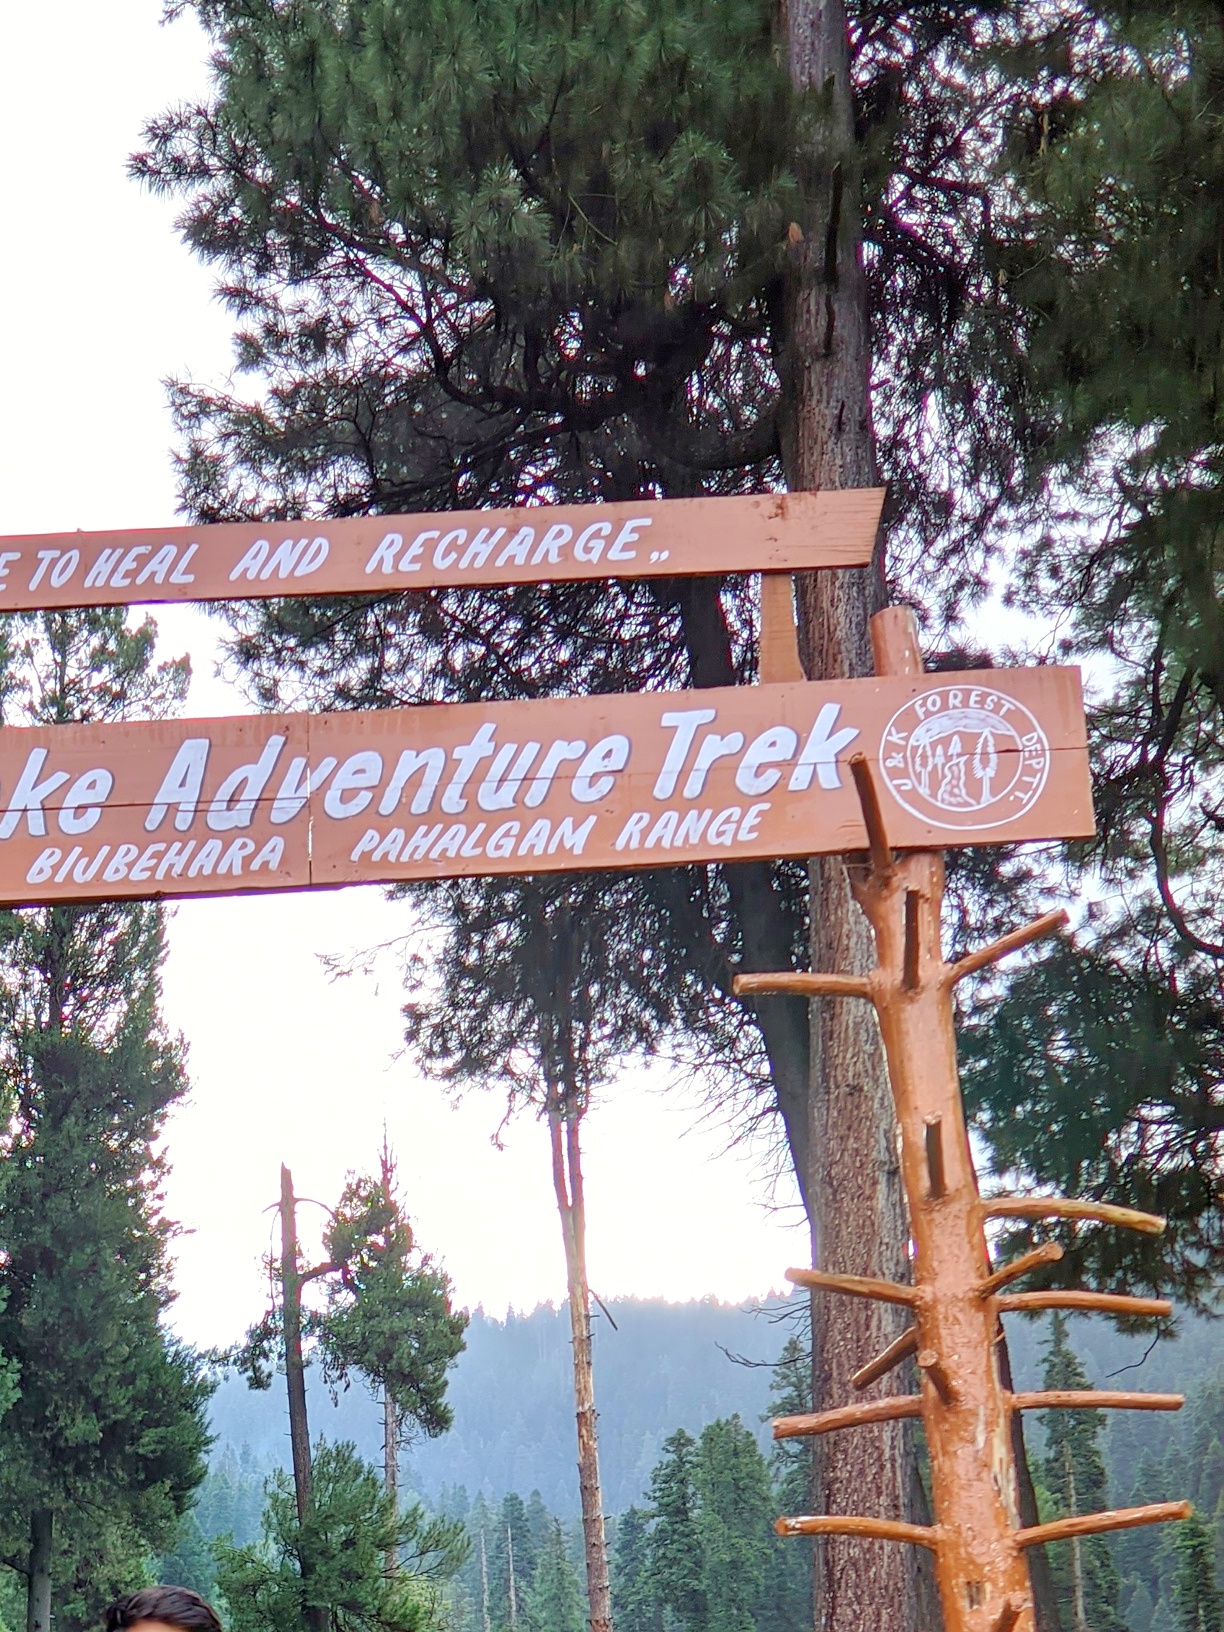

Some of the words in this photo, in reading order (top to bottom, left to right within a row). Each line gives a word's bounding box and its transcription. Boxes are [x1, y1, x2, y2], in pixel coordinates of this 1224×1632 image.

[28, 548, 80, 592] TO
[83, 542, 200, 588] HEAL
[228, 536, 330, 581] AND
[913, 689, 1017, 721] FOREST
[143, 720, 632, 832] Adventure
[652, 702, 860, 801] Trek
[25, 835, 286, 885] BIJBEHARA
[350, 814, 597, 864] PAHALGAM
[614, 803, 772, 851] RANGE
